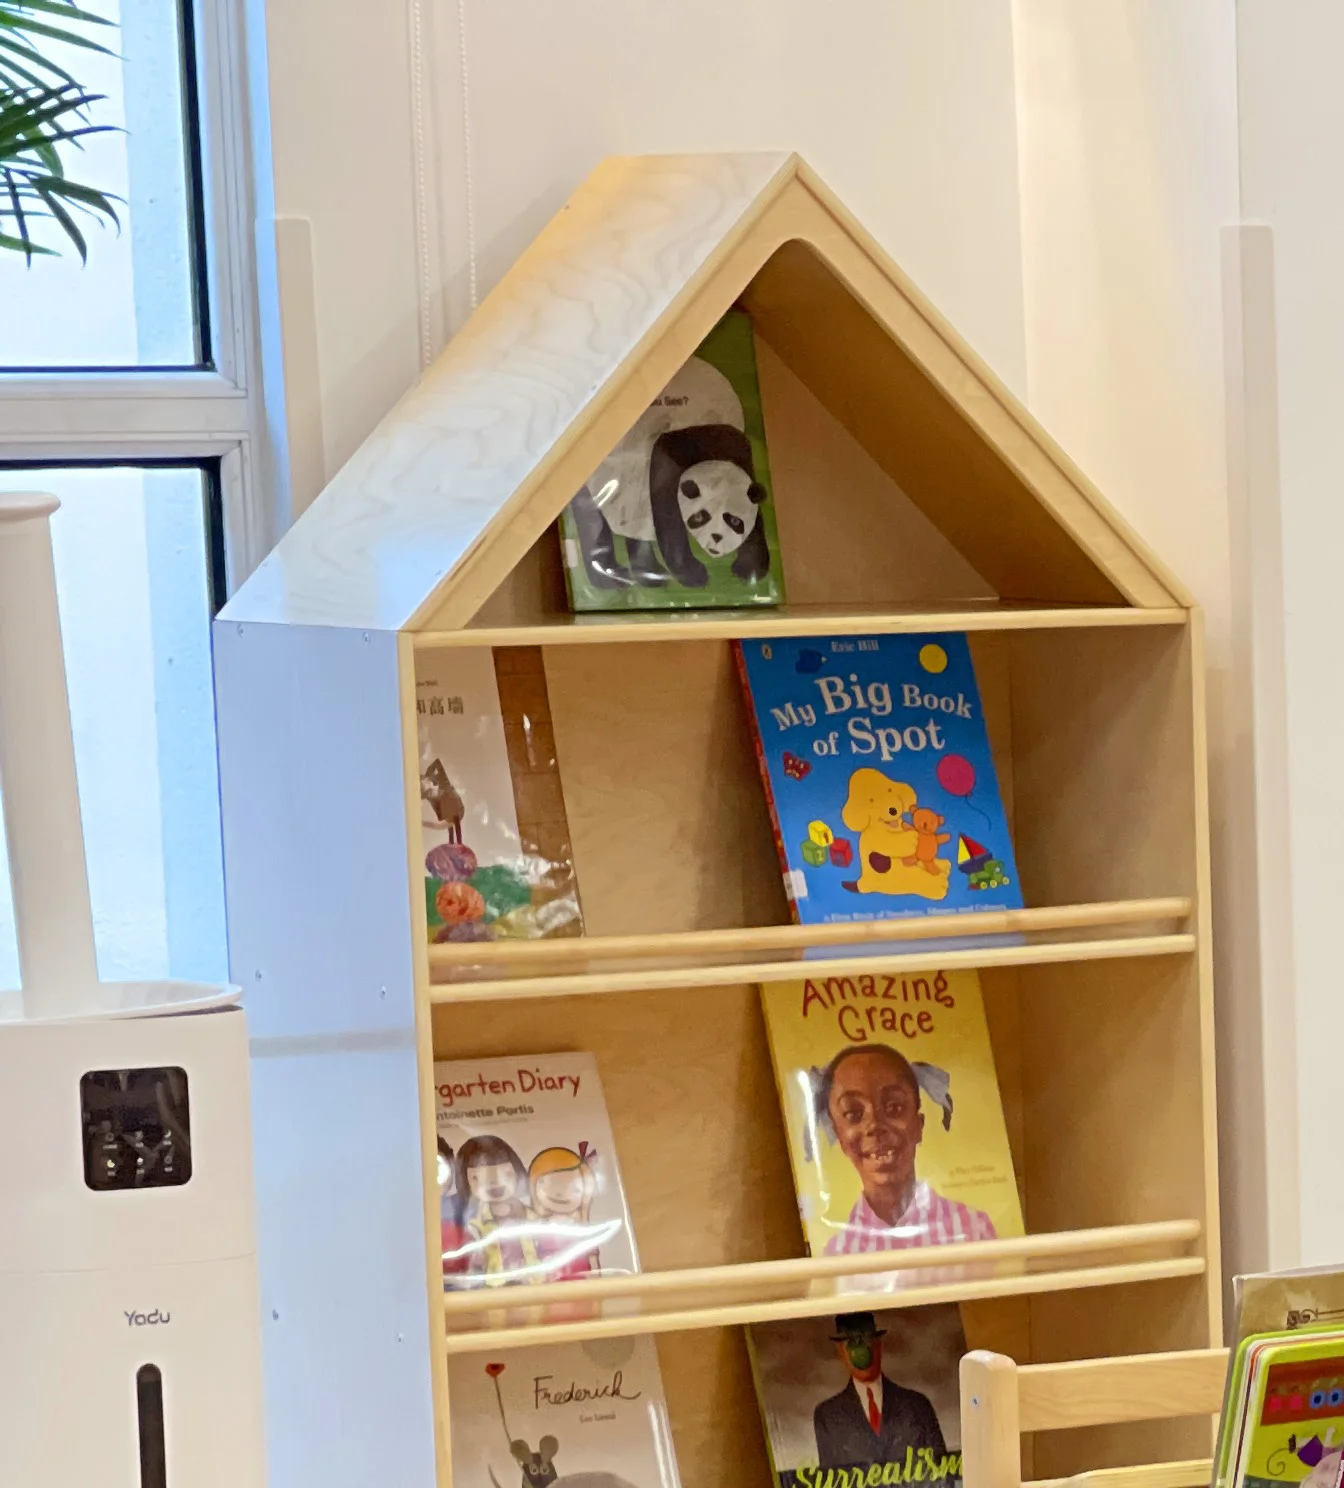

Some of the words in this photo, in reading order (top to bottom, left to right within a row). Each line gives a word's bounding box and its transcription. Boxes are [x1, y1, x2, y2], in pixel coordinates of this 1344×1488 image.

[858, 639, 879, 651] Hill
[769, 702, 817, 732] My
[814, 673, 893, 716] Big
[902, 684, 972, 719] Book
[813, 731, 839, 757] of
[847, 717, 945, 761] Spot
[802, 970, 955, 1018] Amazing
[838, 1005, 934, 1042] Grace
[435, 1072, 516, 1107] garten
[517, 1067, 580, 1098] Diary
[496, 1104, 534, 1116] Portis
[123, 1308, 171, 1327] Yadu
[533, 1369, 641, 1410] Frederick
